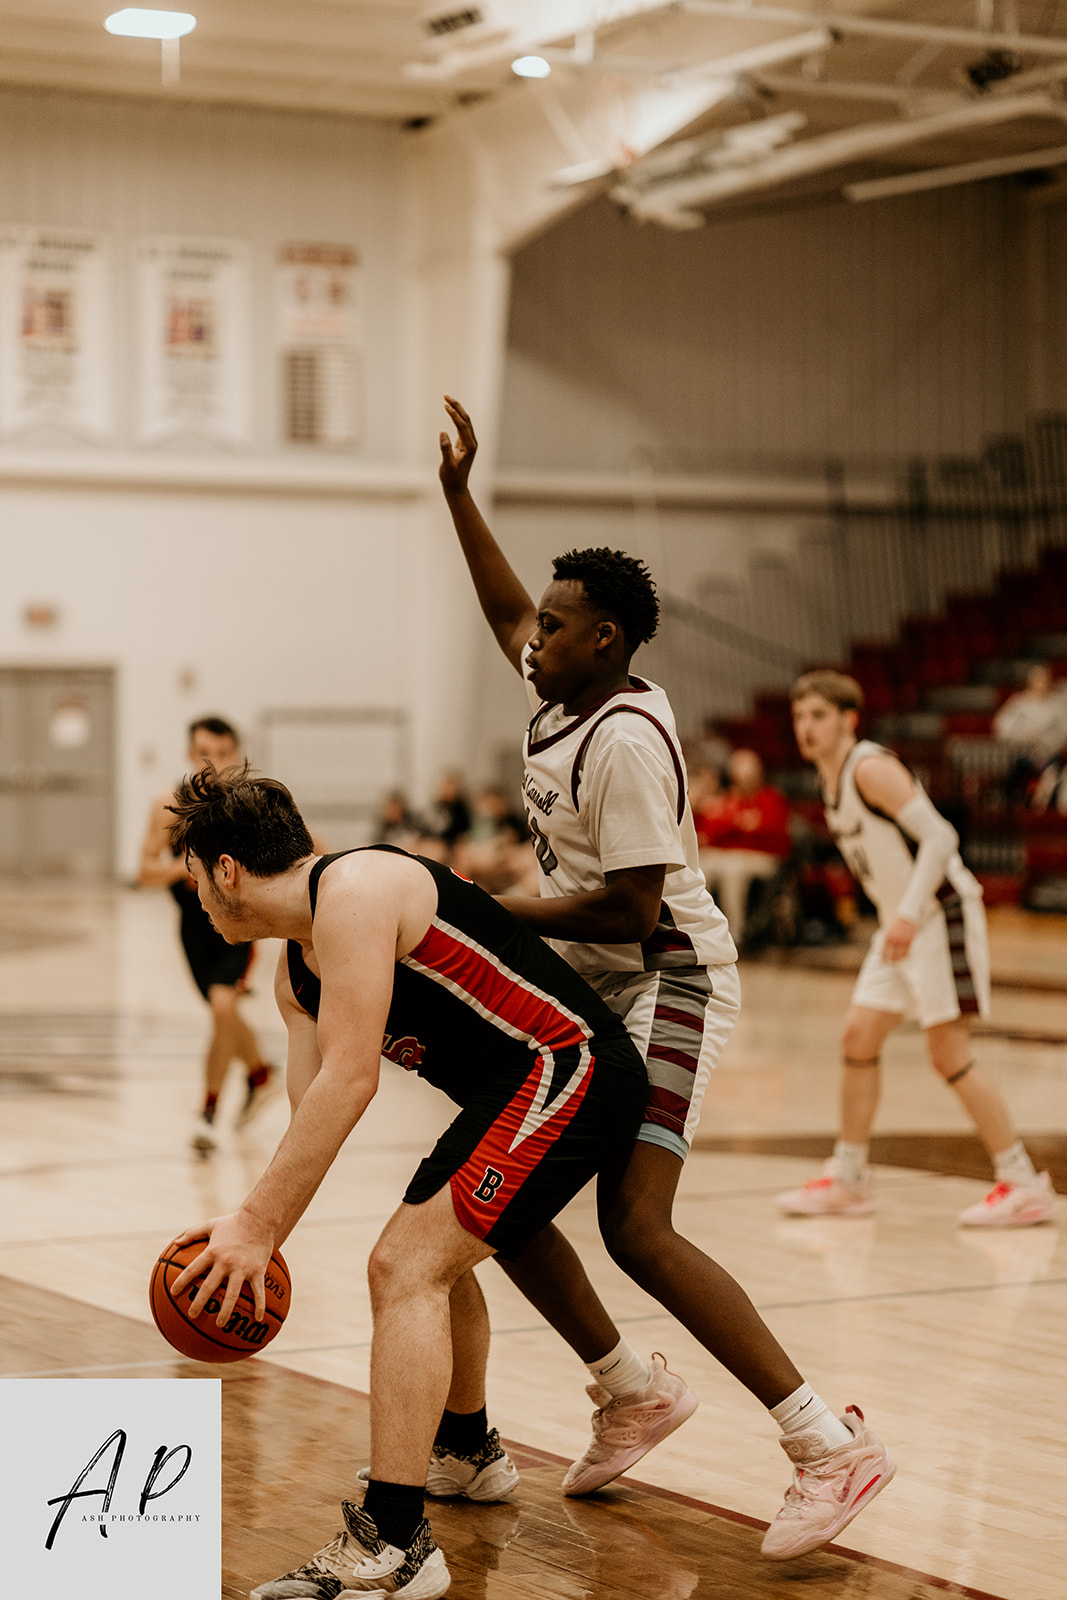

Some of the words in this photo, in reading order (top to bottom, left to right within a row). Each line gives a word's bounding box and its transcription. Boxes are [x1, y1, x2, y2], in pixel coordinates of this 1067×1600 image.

[472, 1165, 505, 1203] B
[264, 1273, 285, 1300] EVO
[188, 1283, 269, 1344] Wilon
